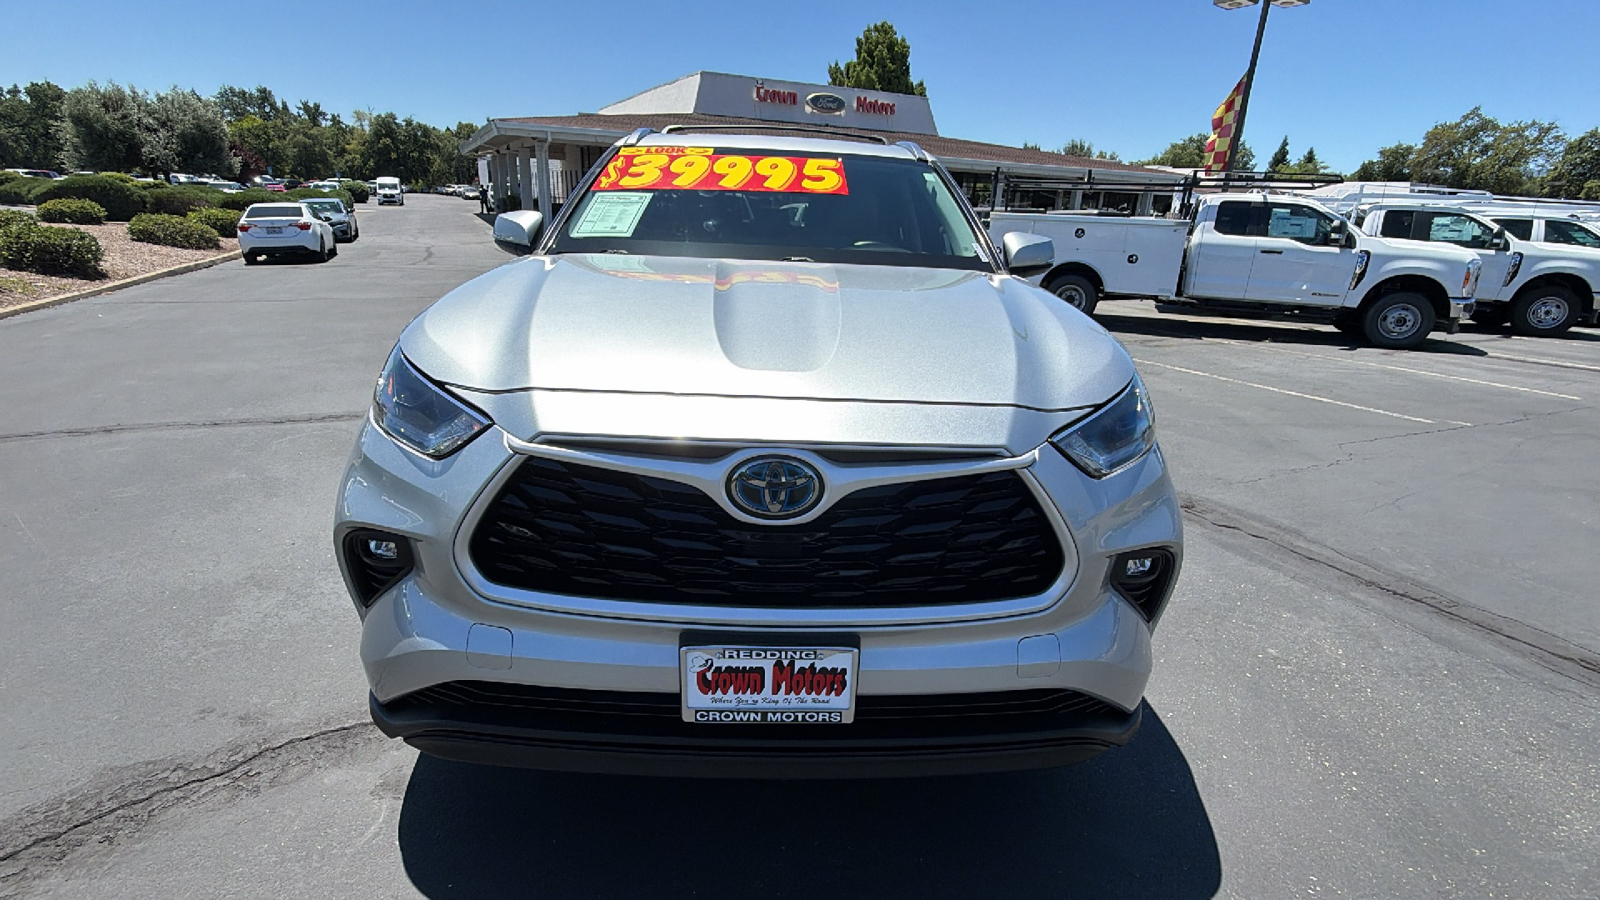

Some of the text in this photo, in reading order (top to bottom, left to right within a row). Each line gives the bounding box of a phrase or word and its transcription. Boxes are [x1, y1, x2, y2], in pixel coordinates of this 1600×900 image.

[755, 85, 798, 106] Crown
[816, 97, 839, 109] Ford
[856, 96, 896, 116] Motors
[600, 154, 843, 191] $39995
[724, 650, 816, 660] REDDING
[696, 658, 848, 697] Crown Motors
[710, 696, 733, 704] Where
[761, 697, 779, 706] King
[782, 697, 792, 706] Of
[795, 697, 808, 705] The
[696, 711, 841, 722] CROWN MOTORS
